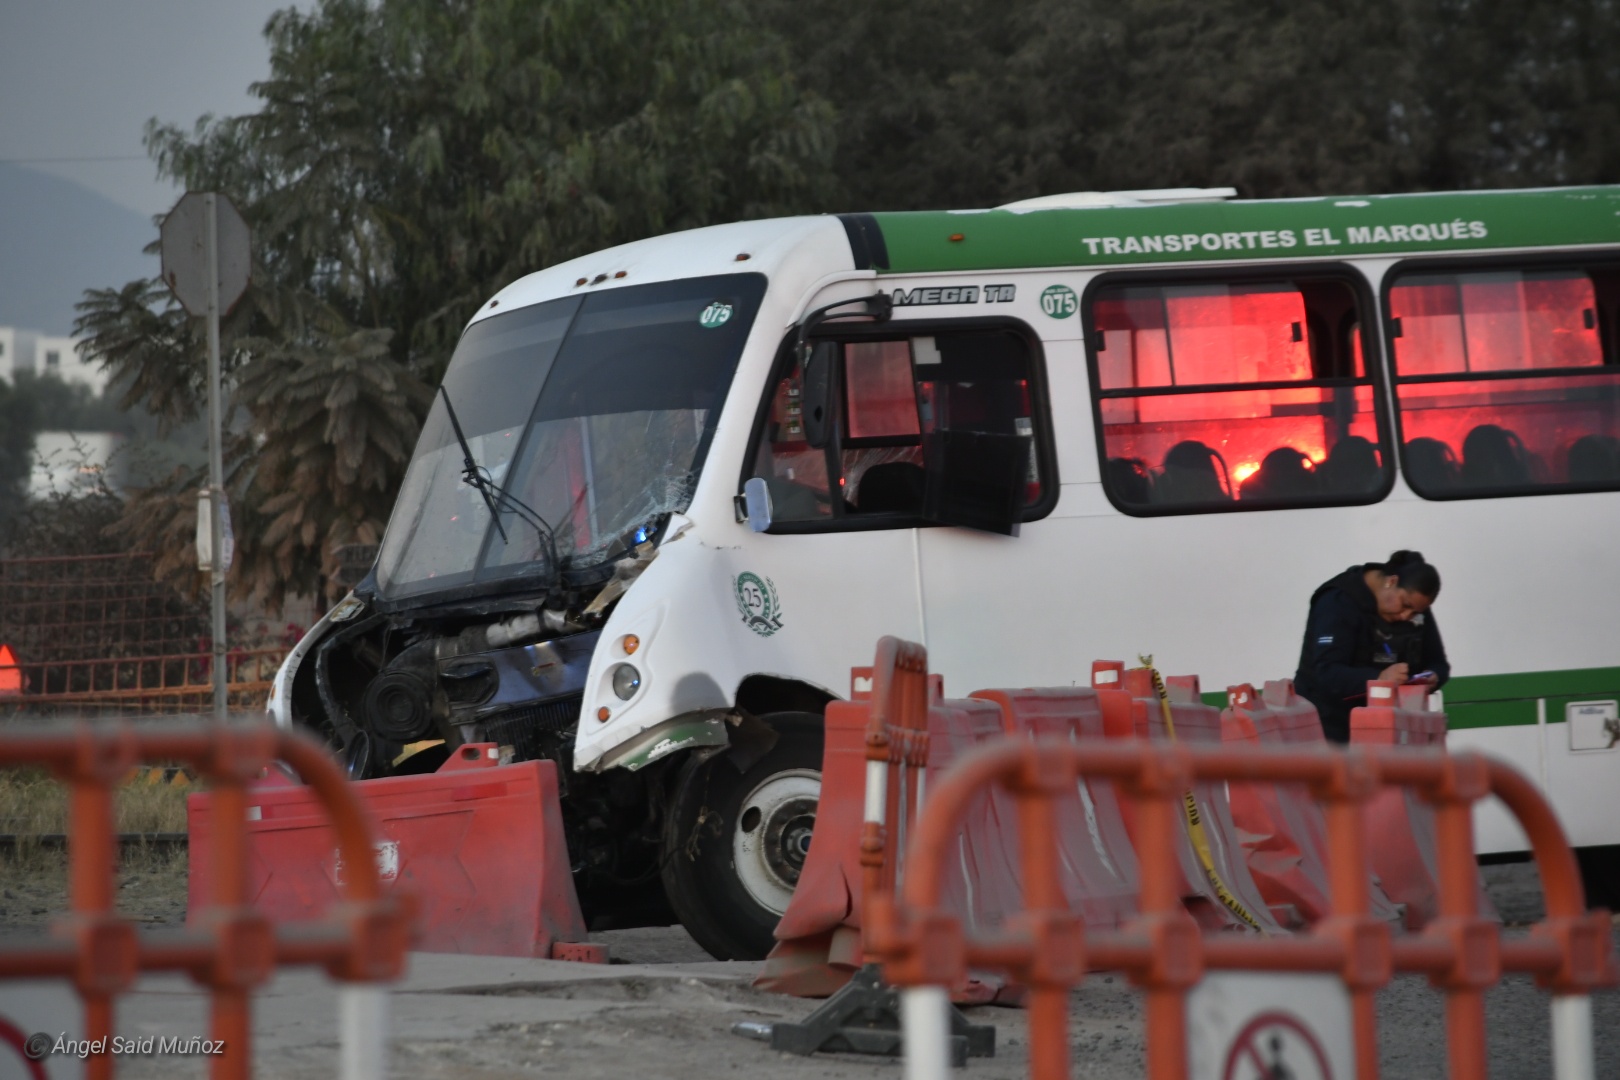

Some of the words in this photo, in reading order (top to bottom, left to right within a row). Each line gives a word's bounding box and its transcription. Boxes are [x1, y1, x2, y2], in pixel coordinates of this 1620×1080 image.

[1082, 230, 1297, 255] TRANSPORTES
[1304, 228, 1341, 246] EL
[1347, 218, 1488, 244] MARQUÉS
[891, 285, 980, 307] MEGA
[1043, 293, 1076, 314] 075
[701, 305, 731, 323] 075
[744, 587, 762, 608] 25
